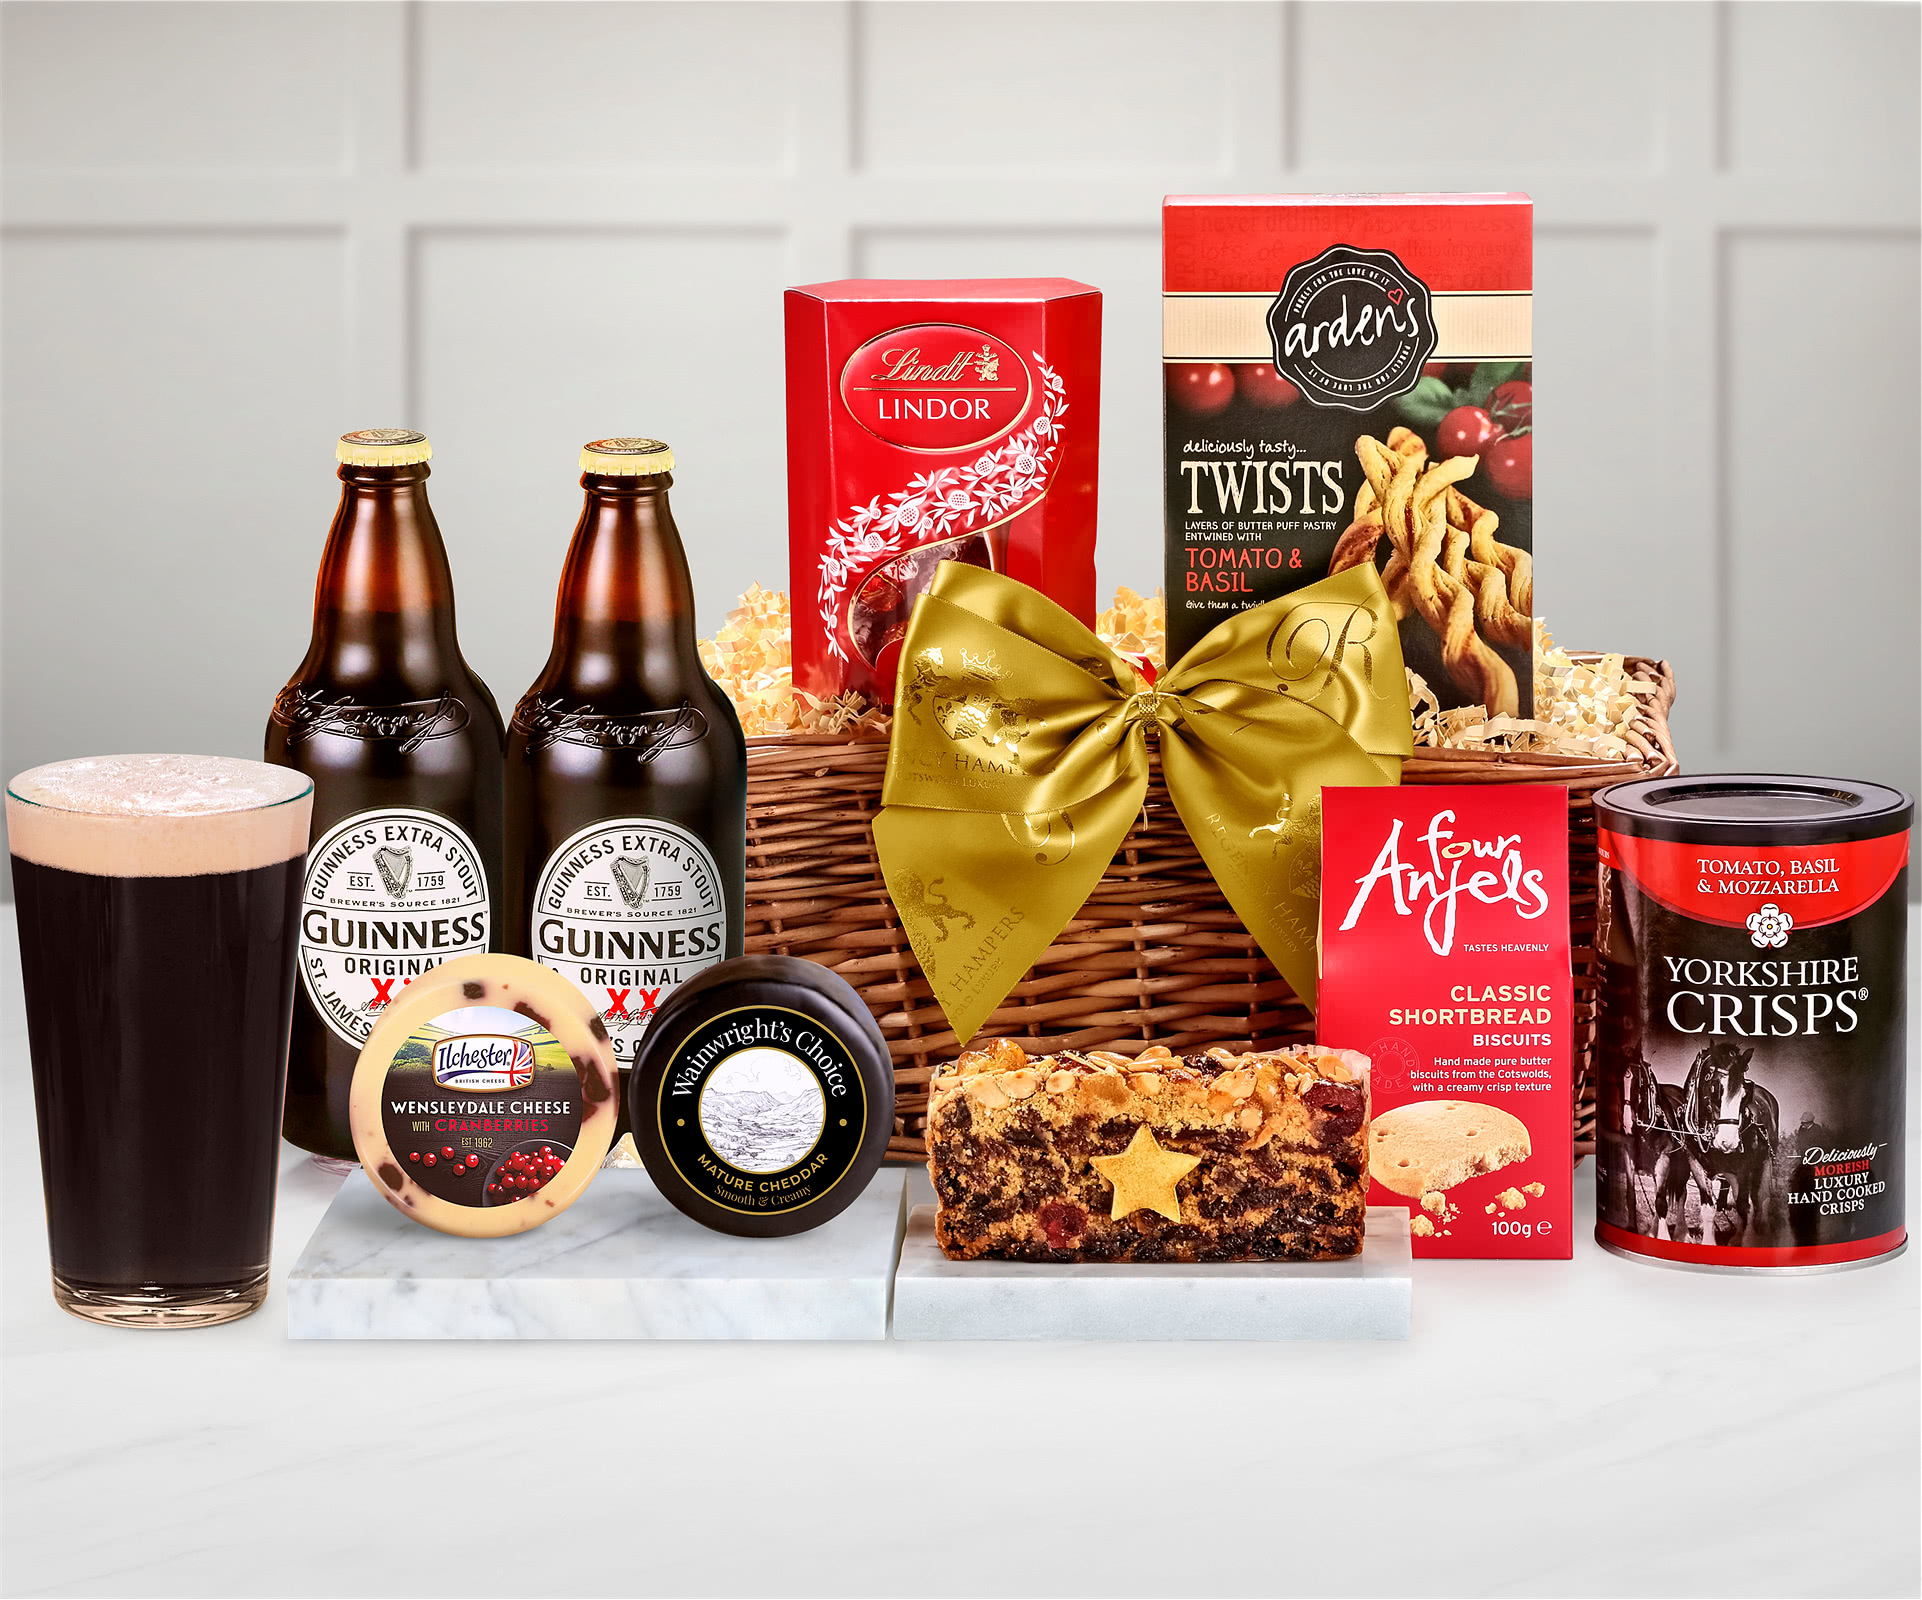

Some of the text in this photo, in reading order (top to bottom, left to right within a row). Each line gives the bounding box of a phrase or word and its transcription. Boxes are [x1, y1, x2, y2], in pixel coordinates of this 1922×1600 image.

[1313, 275, 1327, 289] FOR
[1329, 269, 1343, 280] THE
[1347, 267, 1366, 276] LOVE
[1369, 271, 1379, 280] OF
[1380, 276, 1391, 286] IT
[870, 347, 975, 382] Lindt
[1308, 368, 1318, 378] IT
[1333, 382, 1353, 392] LOVE
[1358, 381, 1373, 391] THE
[879, 398, 991, 420] LINDOR
[1183, 438, 1307, 460] deliciously tasty...
[1180, 460, 1345, 515] TWISTS
[1185, 521, 1337, 530] LAYERS OF BUTTER PUFF PASTRY
[1185, 532, 1262, 541] ENTWINED WITH
[1185, 548, 1303, 569] TOMATO &
[1186, 572, 1253, 593] BASIL
[1185, 600, 1205, 609] Give
[1208, 600, 1229, 609] them
[1417, 810, 1522, 881] four
[311, 825, 478, 900] GUINNESS EXTRA STOUT
[1697, 858, 1840, 877] TOMATO, BASIL
[350, 874, 445, 888] EST. 1759
[548, 835, 714, 910] GUINNESS EXTRA STOUT
[586, 885, 681, 898] EST. 1759
[1338, 818, 1549, 956] Anjels
[1697, 879, 1840, 895] & MOZZARELLA
[329, 897, 461, 908] BREWER'S SOURCE 1821
[567, 907, 697, 917] BREWER'S SOURCE 1821
[1463, 943, 1549, 952] TASTES HEAVENLY
[580, 967, 683, 986] ORIGINAL
[1663, 956, 1859, 987] YORKSHIRE
[310, 957, 373, 1037] ST. JAMES
[1450, 985, 1551, 1002] CLASSIC
[1389, 1008, 1551, 1025] SHORTBREAD
[1473, 1033, 1551, 1046] BISCUITS
[672, 1017, 847, 1098] Wainwright's Choice
[1434, 1056, 1551, 1067] Hand made pure butter
[1410, 1069, 1552, 1080] biscuits from the Cotswolds,
[1412, 1082, 1552, 1094] with a creamy crisp texture
[391, 1101, 570, 1115] WENSLEYDALE CHEESE
[412, 1119, 549, 1132] WITH CRANBERRIES
[461, 1137, 493, 1148] EST 1962
[1803, 1142, 1878, 1165] Deliciously
[697, 1153, 829, 1193] MATURE CHEDDAR
[1814, 1159, 1870, 1176] MOREISH
[1814, 1171, 1870, 1190] LUXURY
[714, 1184, 812, 1207] Smooth & Creamy
[1787, 1181, 1886, 1204] HAND COOKED
[1820, 1198, 1865, 1216] CRISPS
[1491, 1220, 1532, 1239] 100g
